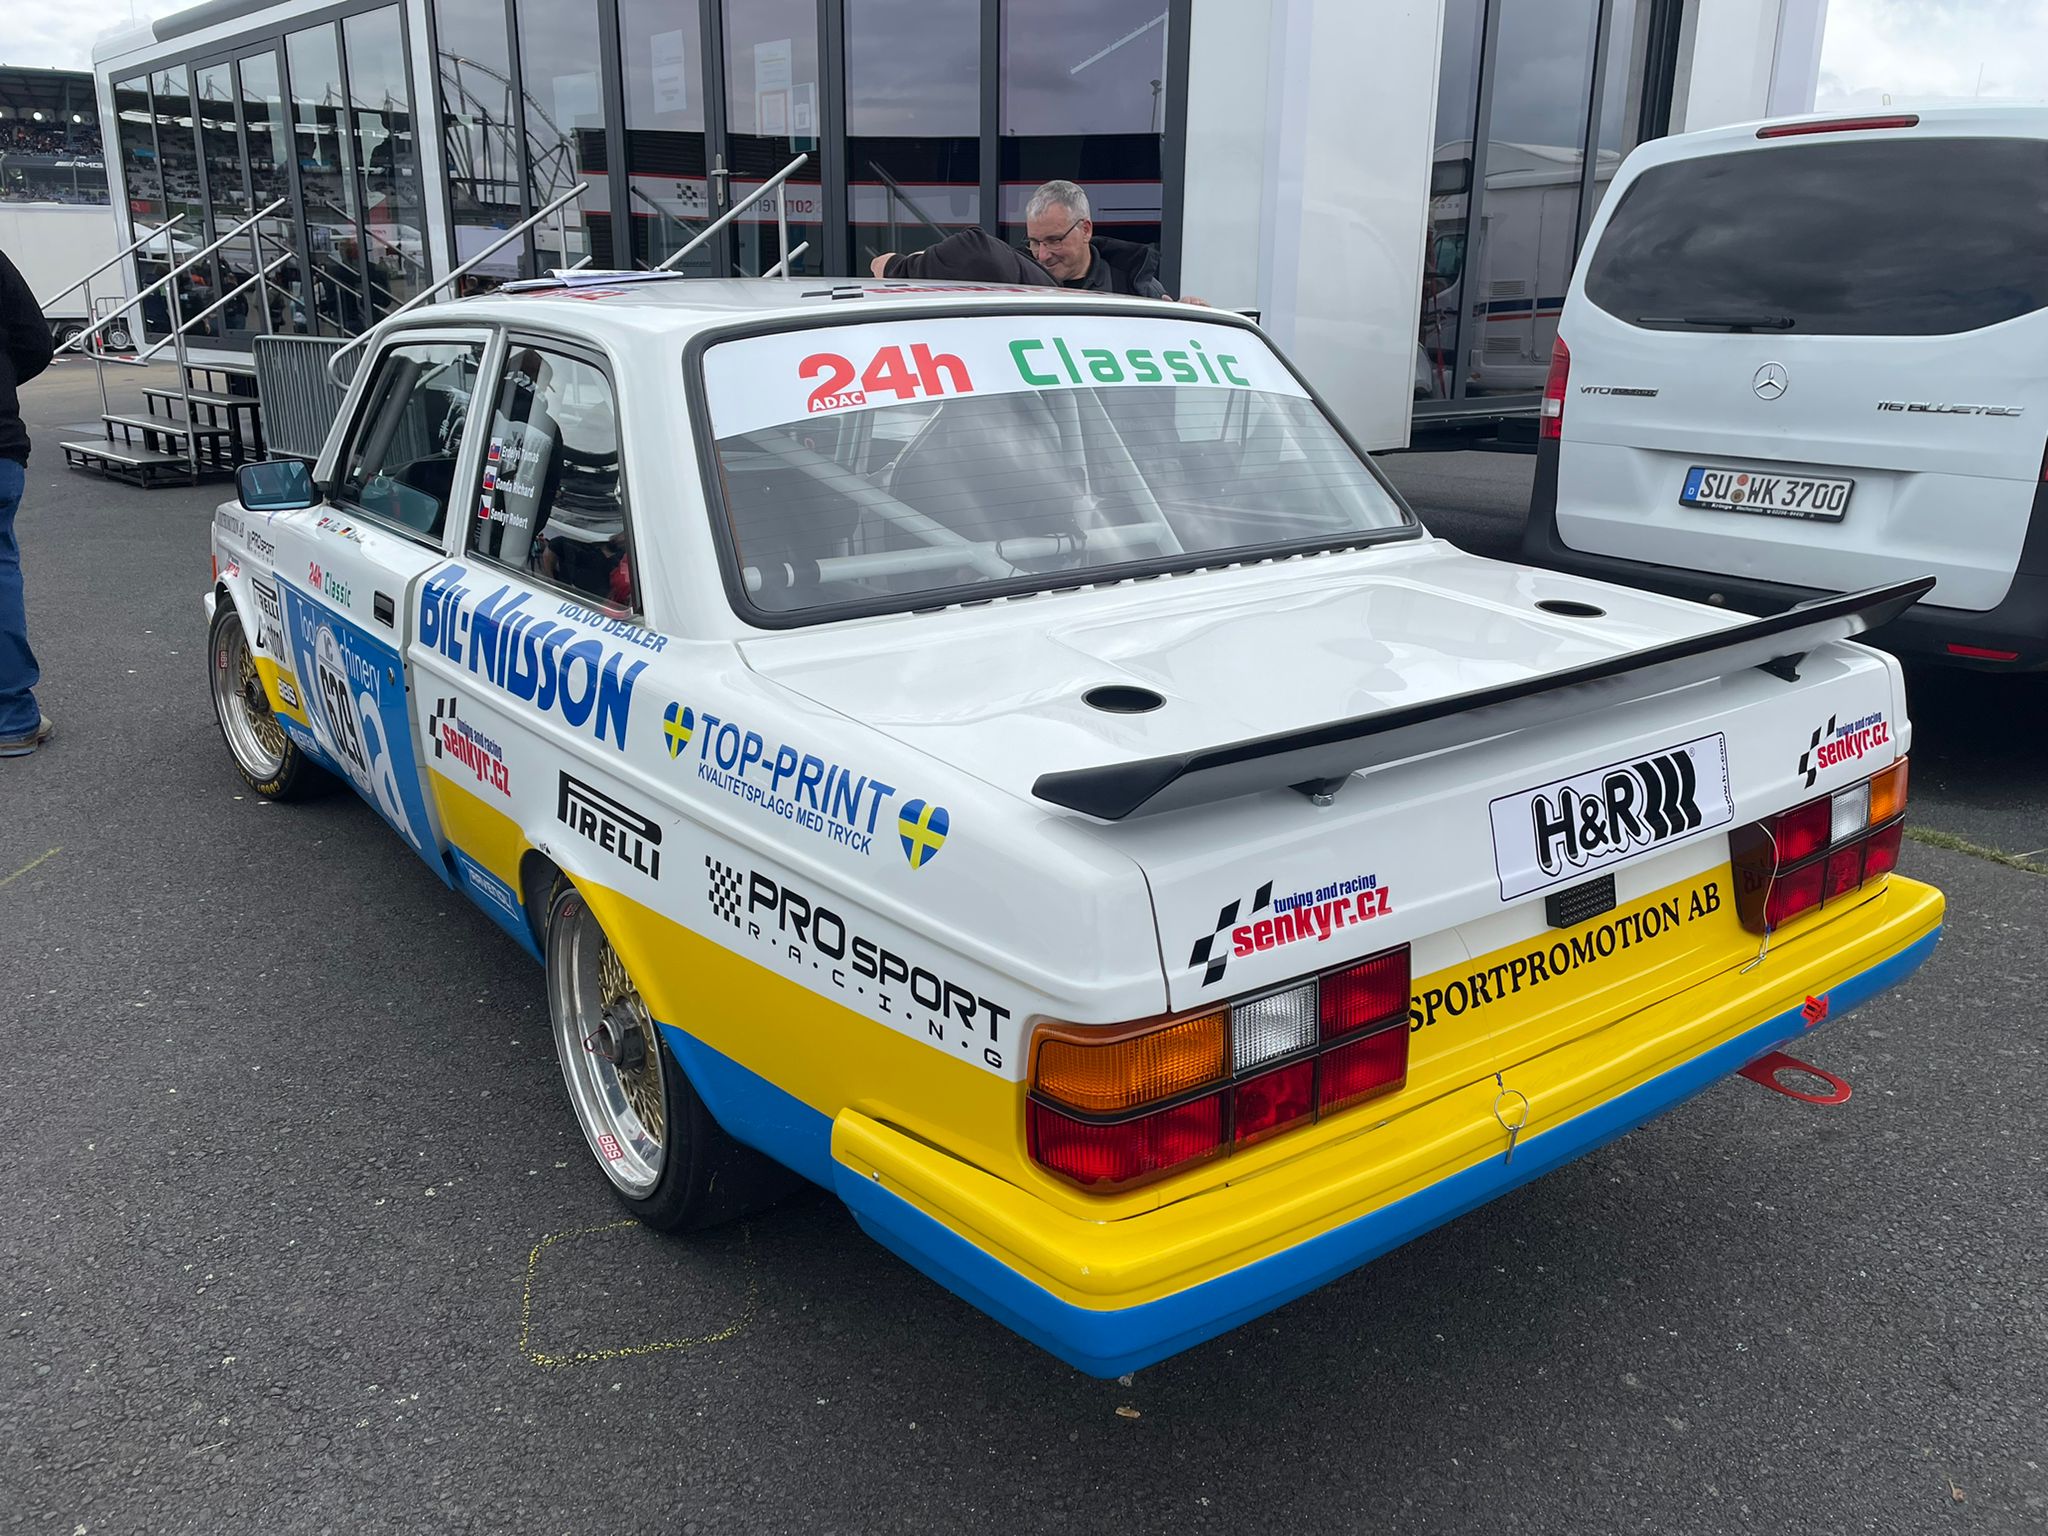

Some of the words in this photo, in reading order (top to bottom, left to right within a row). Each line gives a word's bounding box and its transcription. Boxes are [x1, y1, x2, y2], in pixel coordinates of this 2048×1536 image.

[71, 161, 104, 169] AMG
[799, 343, 974, 412] 24h
[1008, 337, 1251, 387] Classic
[1580, 385, 1611, 396] VITO
[810, 391, 866, 412] ADAC
[1701, 473, 1733, 500] SU
[1746, 477, 1780, 506] WK
[1781, 481, 1846, 511] 3700
[509, 513, 528, 529] Robert
[325, 571, 351, 608] Classic
[556, 602, 604, 628] VOLVO
[602, 618, 668, 653] DEALER
[442, 722, 511, 798] senkyr.cz
[1817, 721, 1889, 769] senkyr.cz
[700, 712, 896, 834] TOP-PRINT
[557, 769, 663, 881] PIRELLI
[698, 762, 793, 820] KVALITETSPLAGG
[796, 807, 823, 833] MED
[827, 819, 873, 856] TRYCK
[1531, 767, 1650, 878] H&R
[1273, 893, 1313, 914] tuning
[1316, 882, 1338, 902] and
[1339, 874, 1377, 895] racing
[1232, 886, 1393, 958] senkyr.cz
[1410, 897, 1680, 1032] SPORTPROMOTION
[1688, 882, 1721, 921] AB
[600, 1135, 622, 1159] BBS
